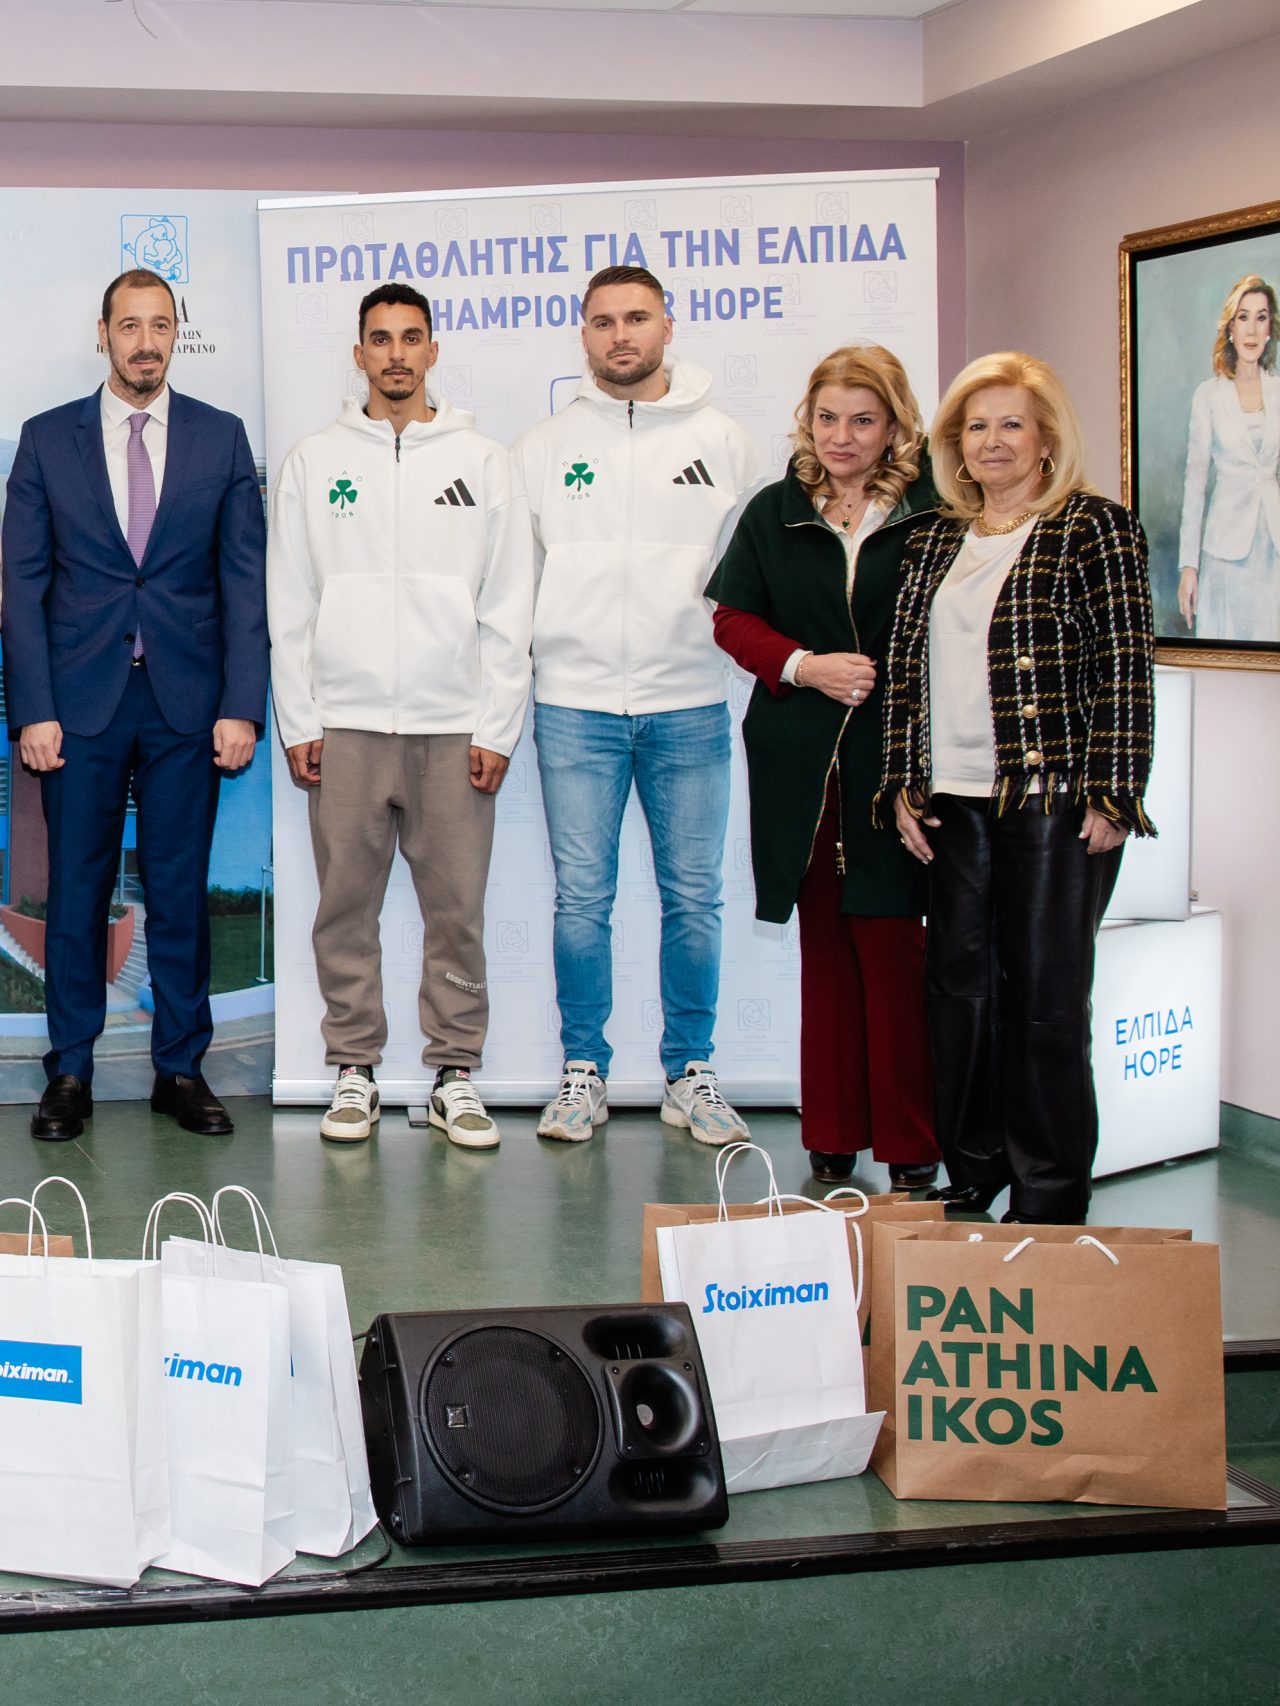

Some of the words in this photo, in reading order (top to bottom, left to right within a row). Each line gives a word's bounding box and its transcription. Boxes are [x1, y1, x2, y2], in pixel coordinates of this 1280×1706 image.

[287, 235, 569, 284] ΠΡΩΤΑΘΛΗΤΗΣ
[584, 232, 649, 272] ΓΙΑ
[660, 228, 740, 268] ΤΗΝ
[757, 222, 907, 265] ΕΛΠΙΔΑ
[689, 286, 784, 322] HOPE
[1115, 1004, 1194, 1046] ΕΛΠΙΔΑ
[1124, 1043, 1183, 1081] HOPE
[702, 1281, 829, 1314] Stoiximan
[906, 1284, 1034, 1335] PAN
[901, 1339, 1159, 1393] ATHINA
[907, 1394, 1064, 1447] IKOS
